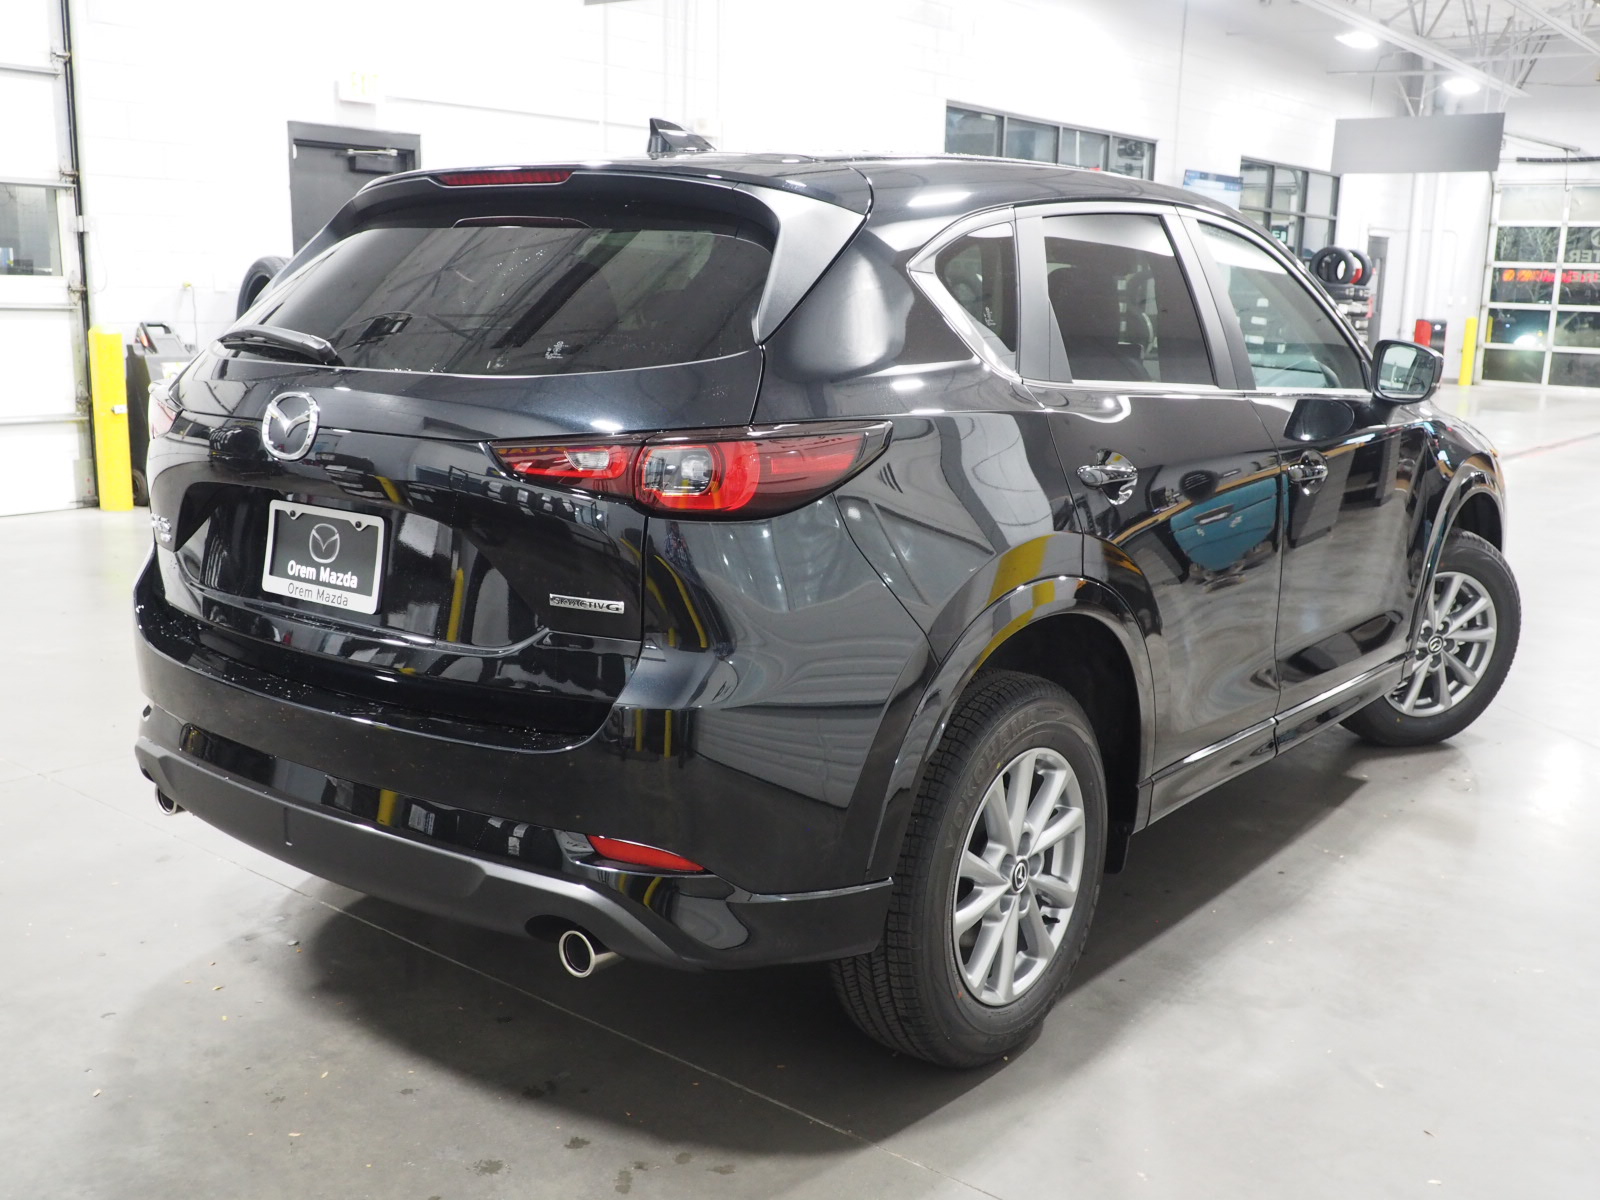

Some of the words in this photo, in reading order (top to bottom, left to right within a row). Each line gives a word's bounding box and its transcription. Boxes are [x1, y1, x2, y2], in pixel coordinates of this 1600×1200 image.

[287, 559, 317, 580] Orem
[319, 564, 358, 589] Mazda
[287, 582, 313, 599] Orem
[316, 588, 349, 607] Mazda
[944, 708, 1037, 849] YOKOHAMA
